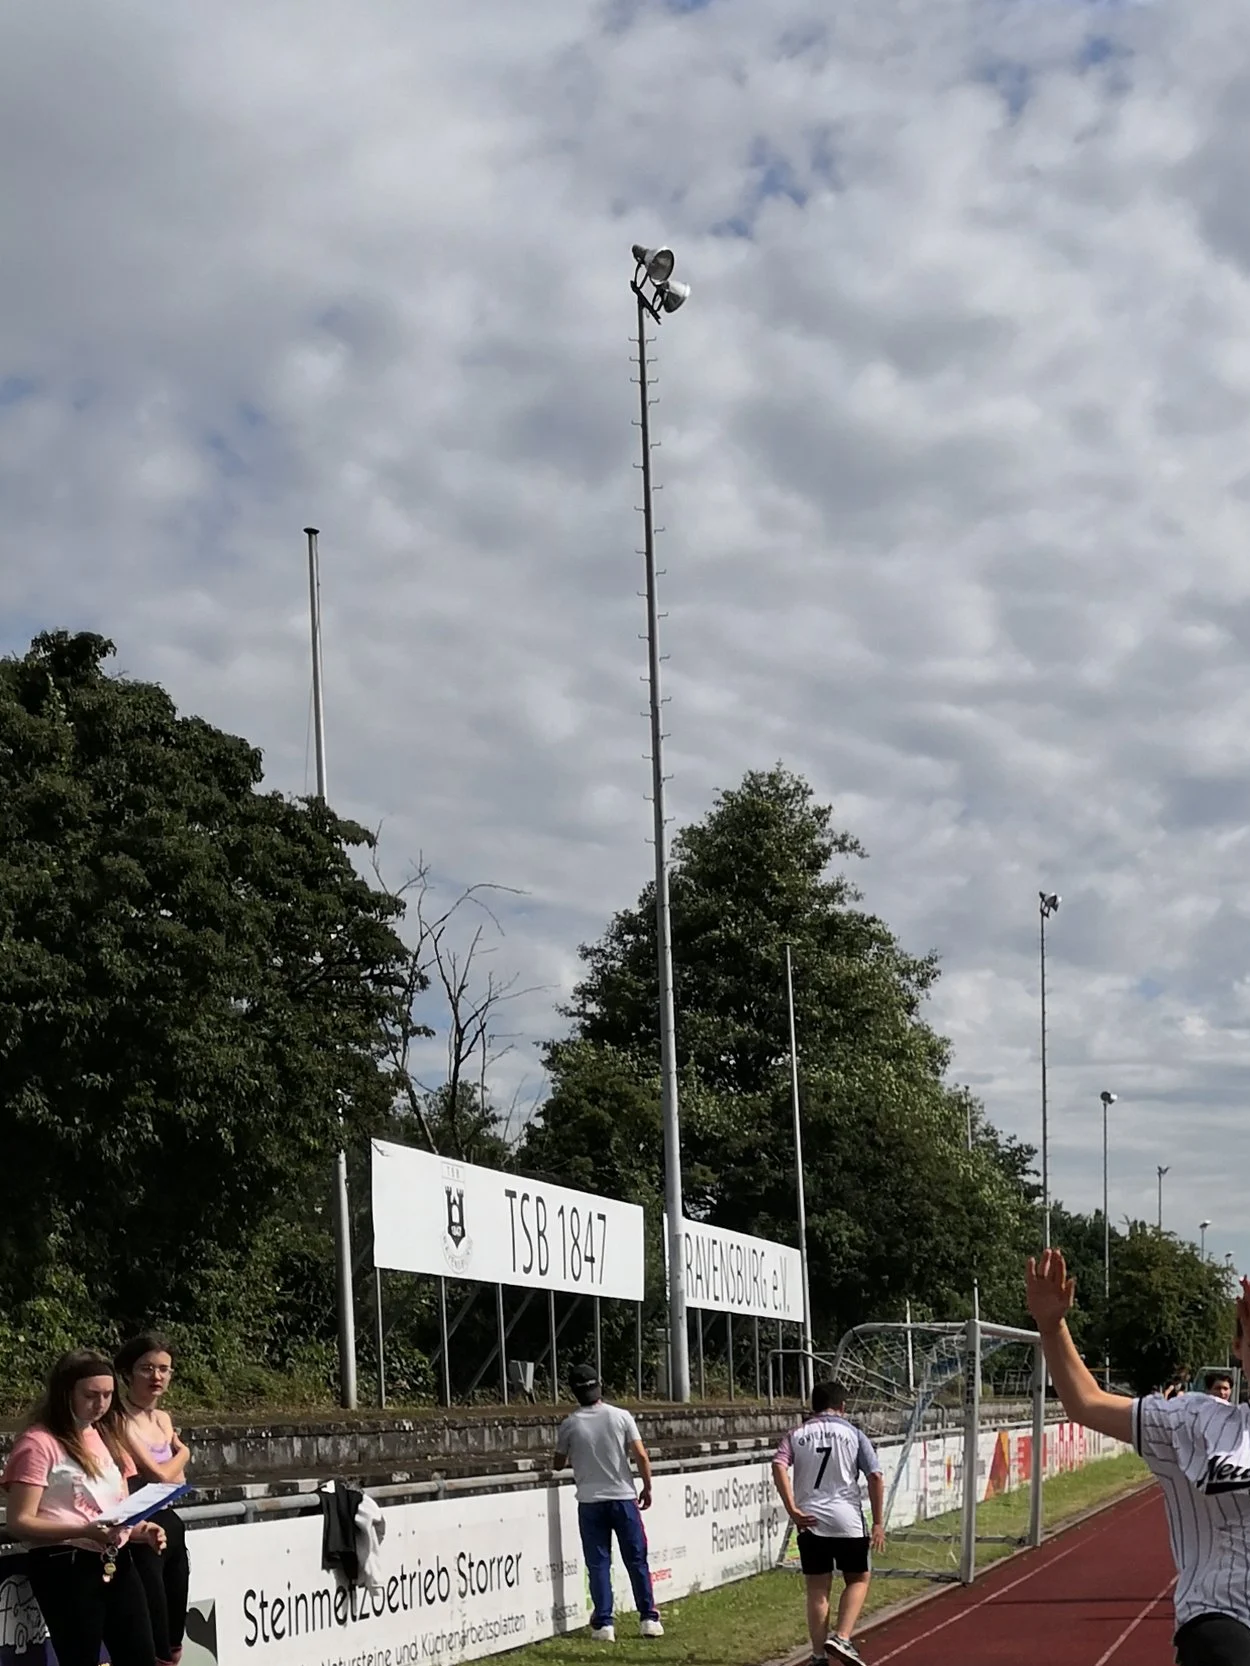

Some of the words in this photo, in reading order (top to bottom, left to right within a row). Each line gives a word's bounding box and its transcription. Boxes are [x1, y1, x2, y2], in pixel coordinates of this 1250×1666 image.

[504, 1188, 550, 1277] TSB
[557, 1204, 607, 1286] 1847
[685, 1232, 768, 1310] RAVENSBURG
[772, 1255, 791, 1313] e.V.
[813, 1446, 833, 1490] 7
[684, 1484, 709, 1519] Bau-
[711, 1478, 730, 1513] und
[711, 1514, 765, 1555] Ravensburg
[456, 1551, 523, 1600] Storrer
[395, 1634, 419, 1666] und
